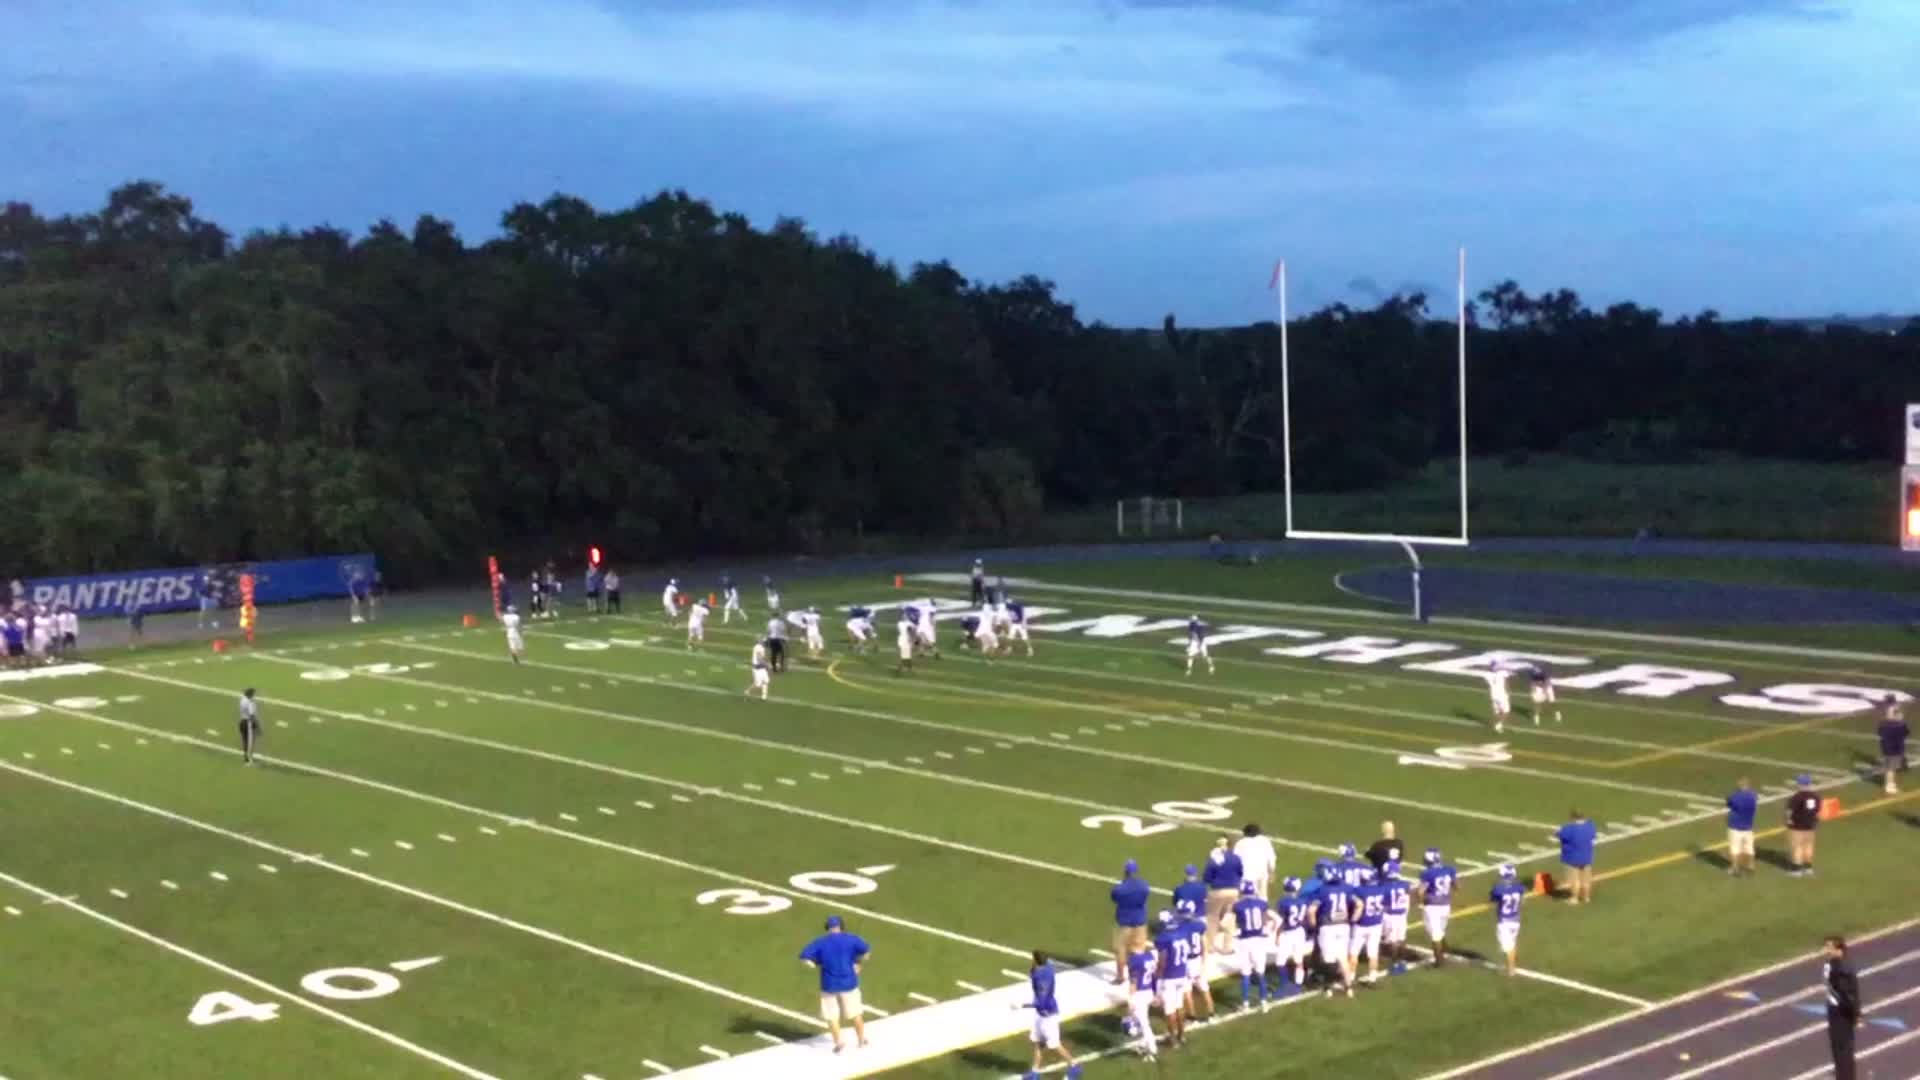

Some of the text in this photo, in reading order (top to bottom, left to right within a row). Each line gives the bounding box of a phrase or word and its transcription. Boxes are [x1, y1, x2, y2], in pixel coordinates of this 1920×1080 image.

[33, 575, 195, 611] PANTHERS
[1399, 745, 1513, 769] 10
[1081, 801, 1233, 837] 20
[696, 871, 878, 915] 30
[1502, 892, 1521, 915] 27
[187, 967, 401, 1025] 40
